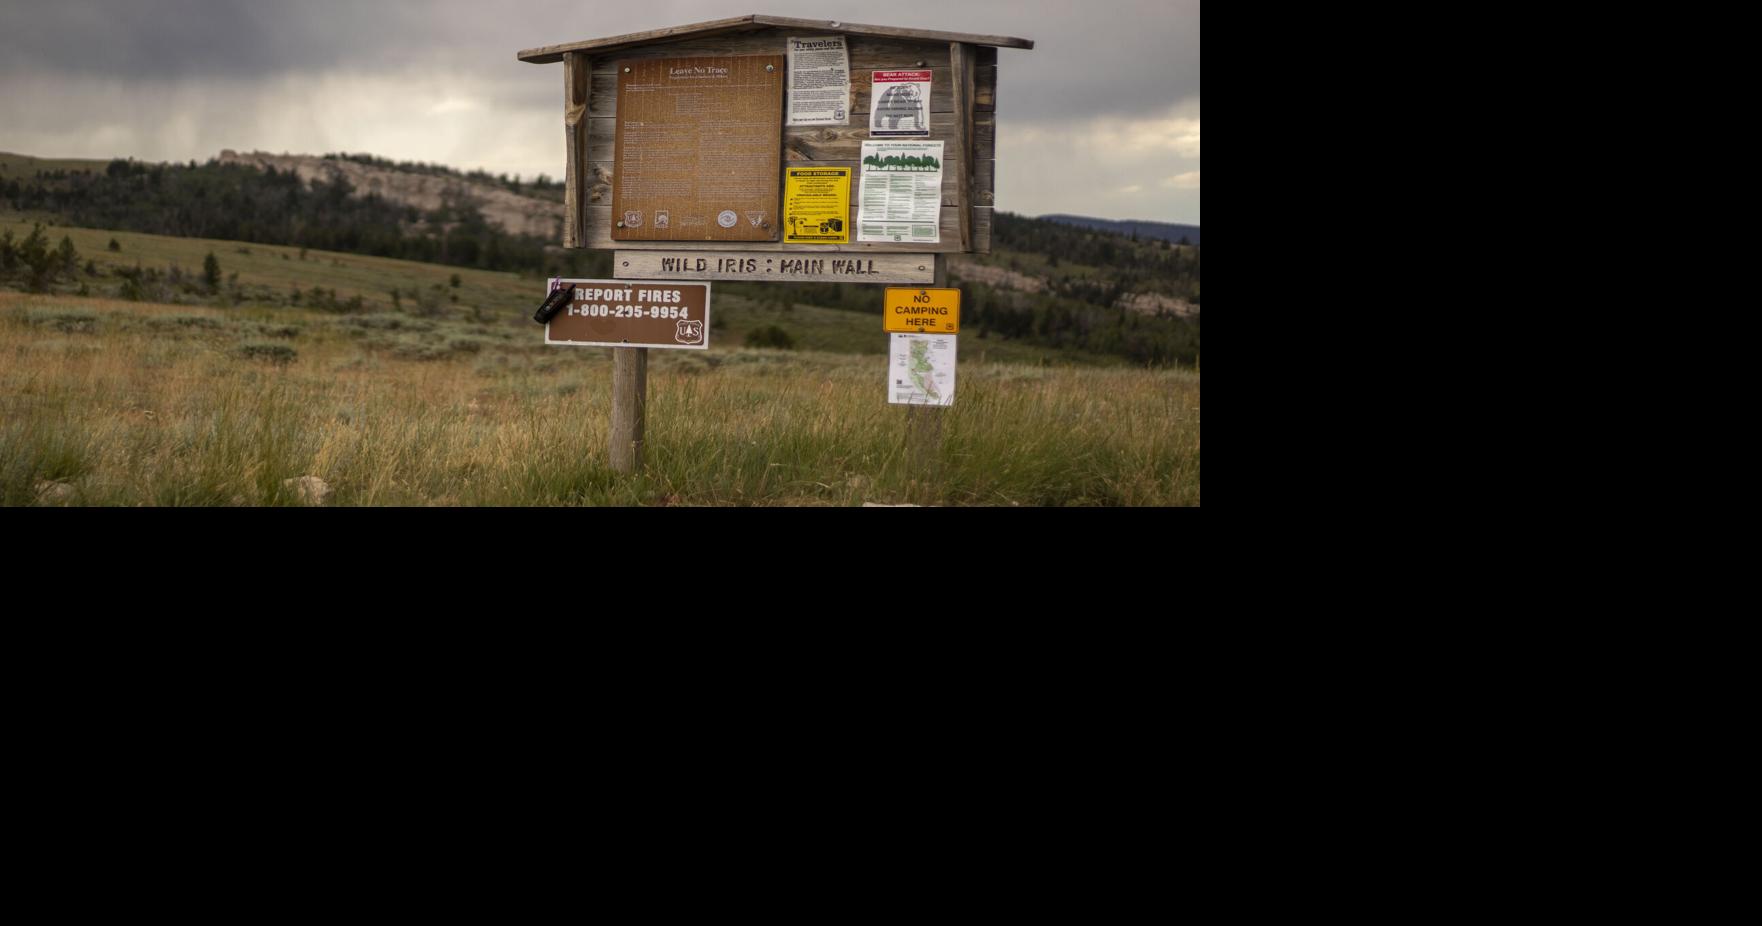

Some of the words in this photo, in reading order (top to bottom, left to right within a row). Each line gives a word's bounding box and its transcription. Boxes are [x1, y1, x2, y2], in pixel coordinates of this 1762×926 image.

[670, 67, 692, 75] Leave
[694, 66, 705, 74] No
[707, 66, 728, 74] Trace
[662, 258, 706, 272] WILD
[718, 258, 756, 272] IRIS
[780, 259, 824, 274] MAIN
[832, 260, 879, 274] WALL
[574, 288, 632, 301] REPORT
[638, 289, 681, 303] FIRES
[913, 295, 931, 303] NO
[895, 306, 948, 315] CAMPING
[906, 317, 936, 326] HERE
